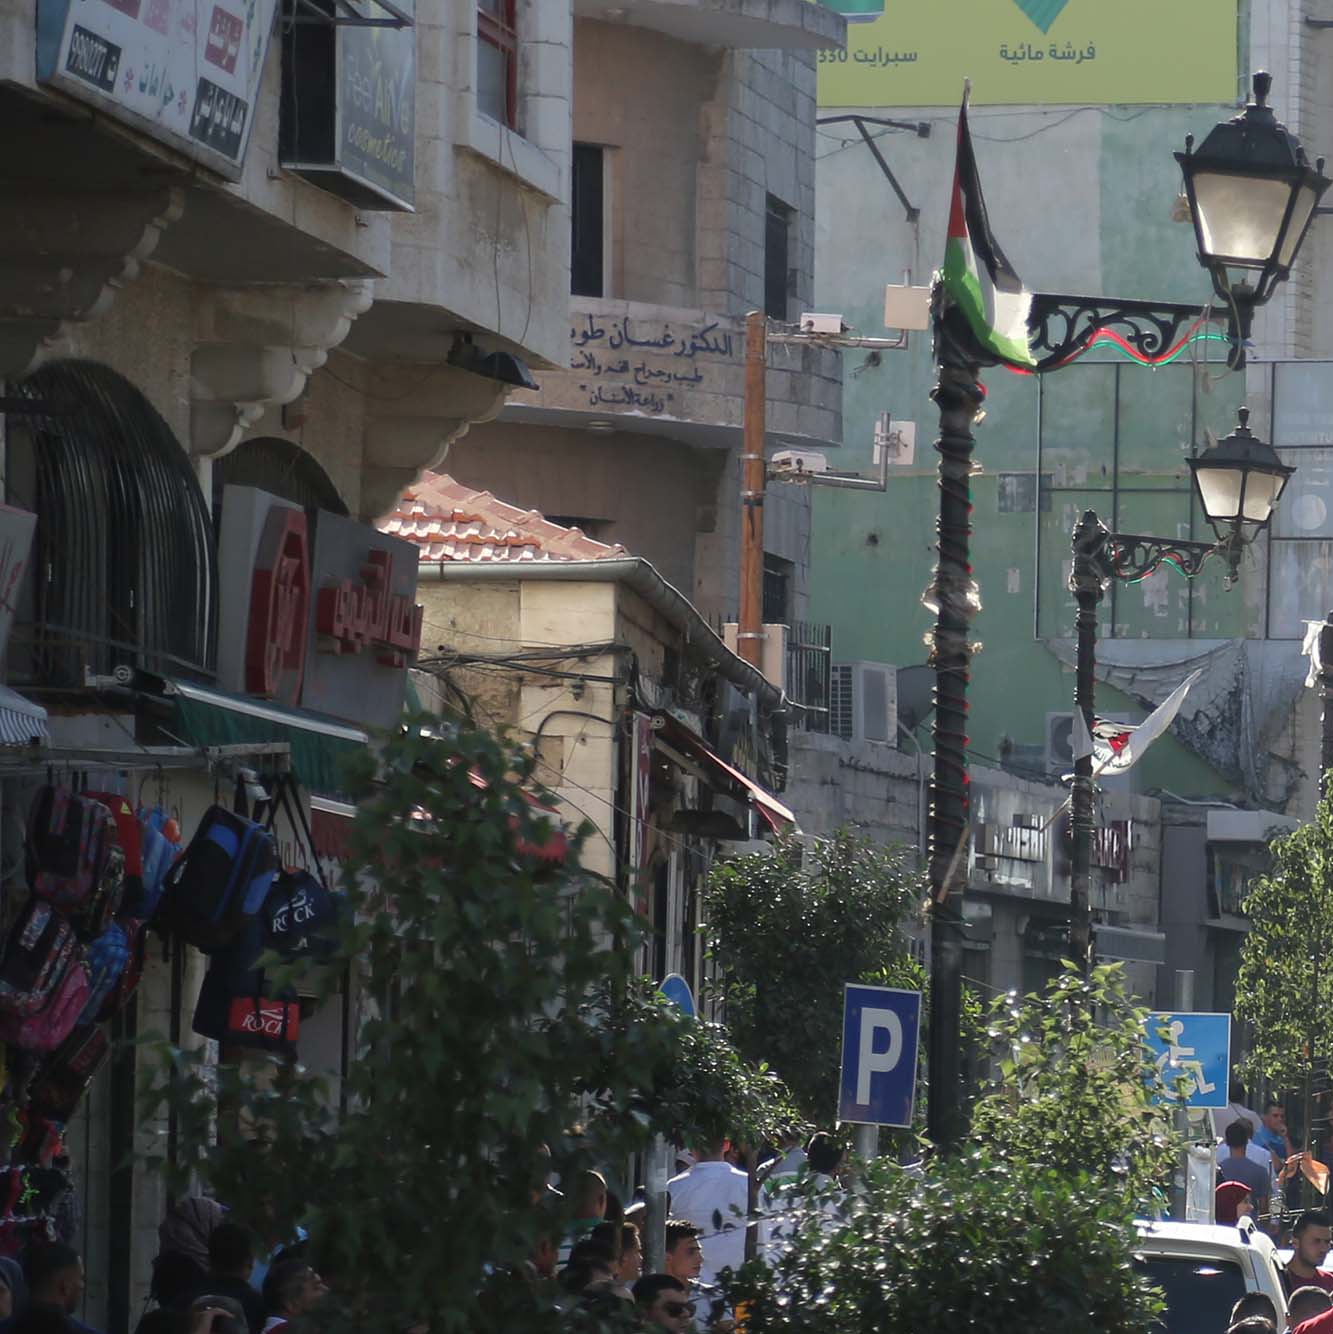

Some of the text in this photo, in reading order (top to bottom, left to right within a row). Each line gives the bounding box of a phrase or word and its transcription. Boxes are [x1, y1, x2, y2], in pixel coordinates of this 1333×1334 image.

[818, 47, 918, 67] سبرايت 330
[999, 41, 1096, 65] فرشة مائية
[609, 317, 675, 348] غسان
[673, 322, 733, 357] الدكتور
[856, 1007, 902, 1107] P
